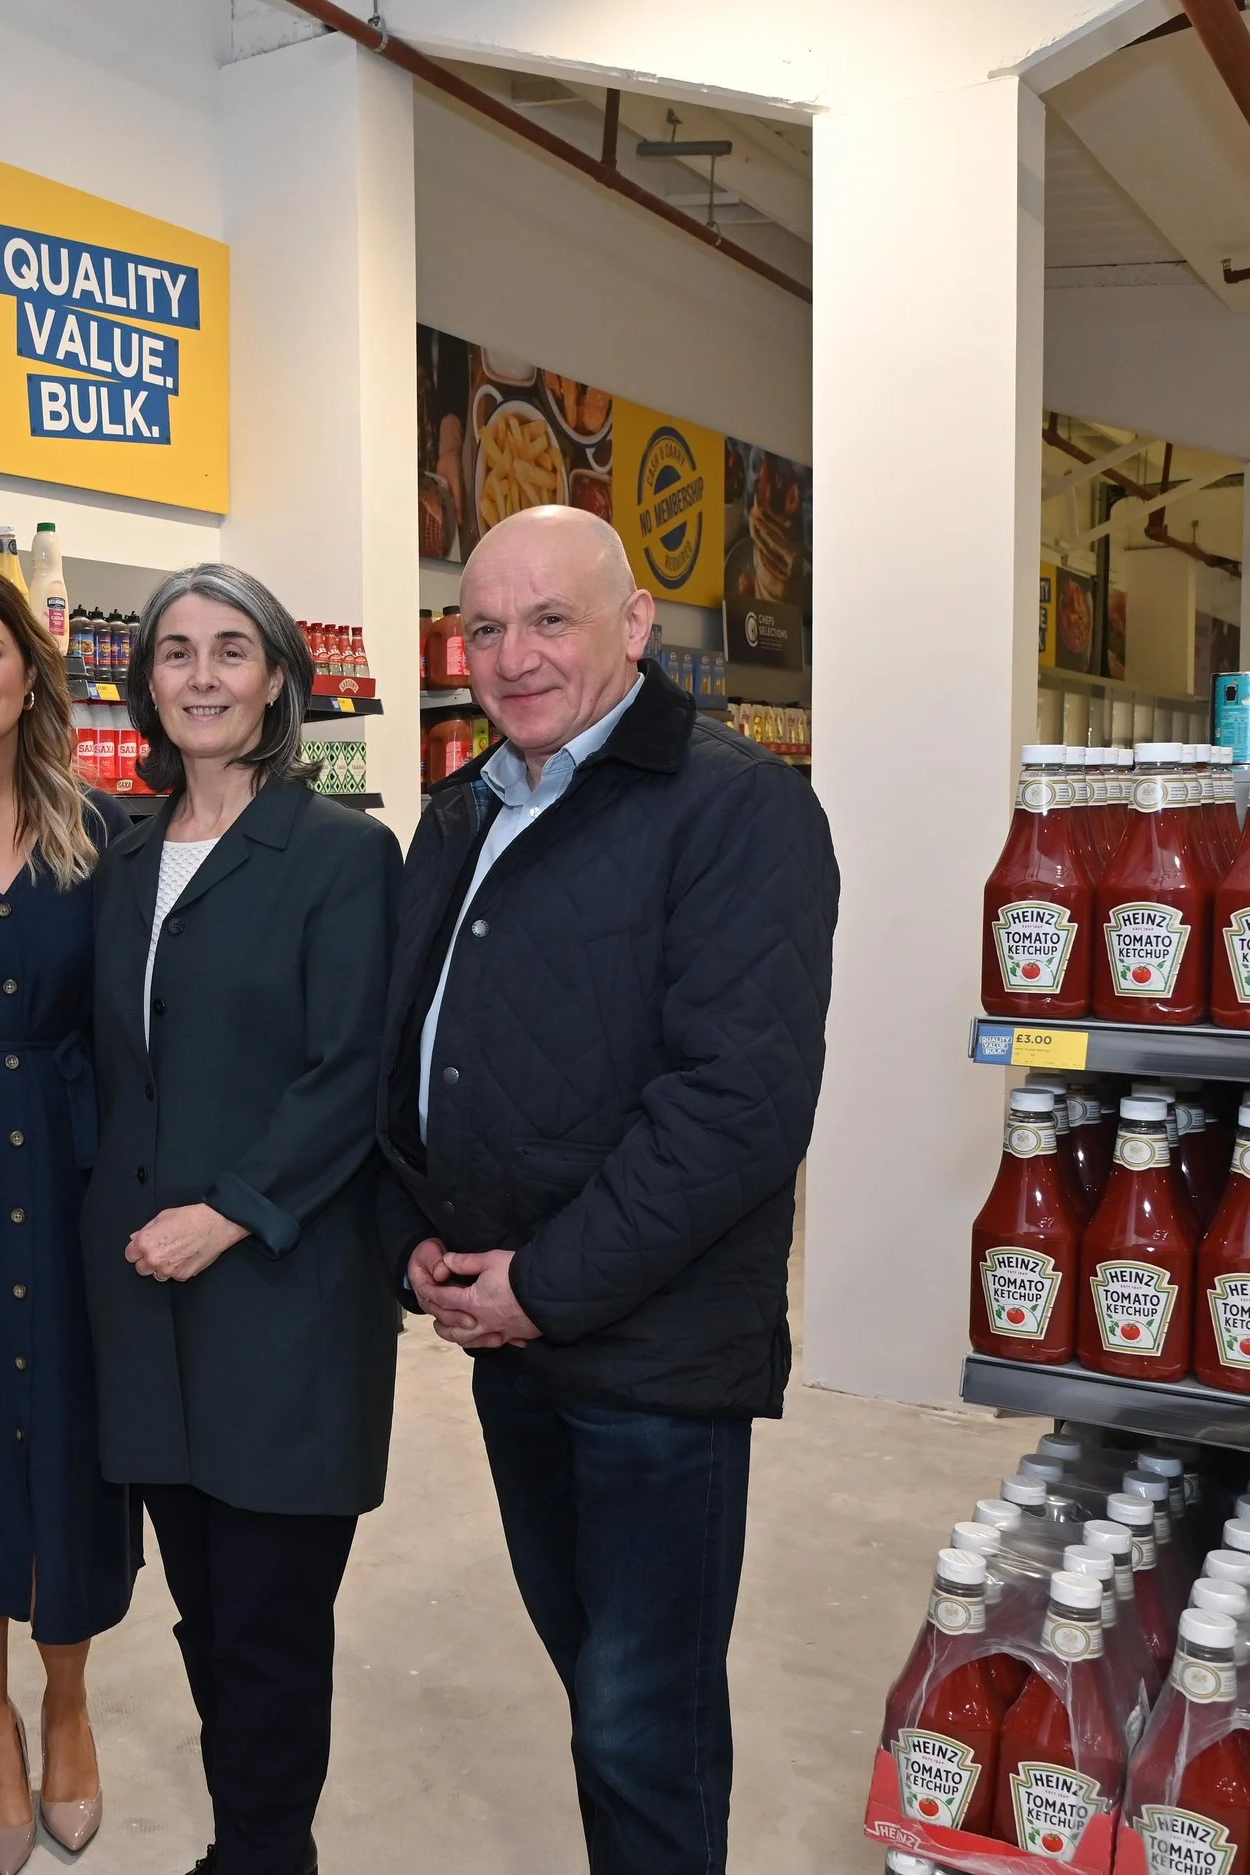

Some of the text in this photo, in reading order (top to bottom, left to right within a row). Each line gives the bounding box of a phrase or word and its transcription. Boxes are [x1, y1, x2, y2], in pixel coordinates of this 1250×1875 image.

[3, 237, 187, 319] QUALITY
[24, 301, 173, 389] VALUE.
[40, 381, 160, 438] BULK.
[646, 454, 659, 486] CASH
[640, 476, 704, 537] NO MEMBERSHIP
[759, 626, 788, 639] SELECTIONS
[1011, 910, 1055, 926] HEINZ
[1122, 912, 1167, 928] HEINZ
[1005, 931, 1061, 946] TOMATO
[1116, 934, 1172, 947] TOMATO
[1007, 944, 1058, 957] KETCHUP
[1118, 948, 1169, 959] KETCHUP
[1016, 1033, 1052, 1046] £3.00
[996, 1255, 1040, 1274] HEINZ
[991, 1274, 1045, 1293] TOMATO
[1109, 1269, 1155, 1287] HEINZ
[993, 1288, 1042, 1303] KETCHUP
[1103, 1289, 1160, 1307] TOMATO
[1106, 1304, 1158, 1318] KETCHUP
[911, 1739, 959, 1764] HEINZ
[904, 1756, 963, 1786] TOMATO
[905, 1776, 960, 1797] KETCHUP
[1032, 1772, 1084, 1798] HEINZ
[1026, 1790, 1088, 1820] TOMATO
[1026, 1807, 1085, 1831] KETCHUP
[1157, 1816, 1211, 1844] HEINZ
[1149, 1835, 1216, 1867] TOMATO
